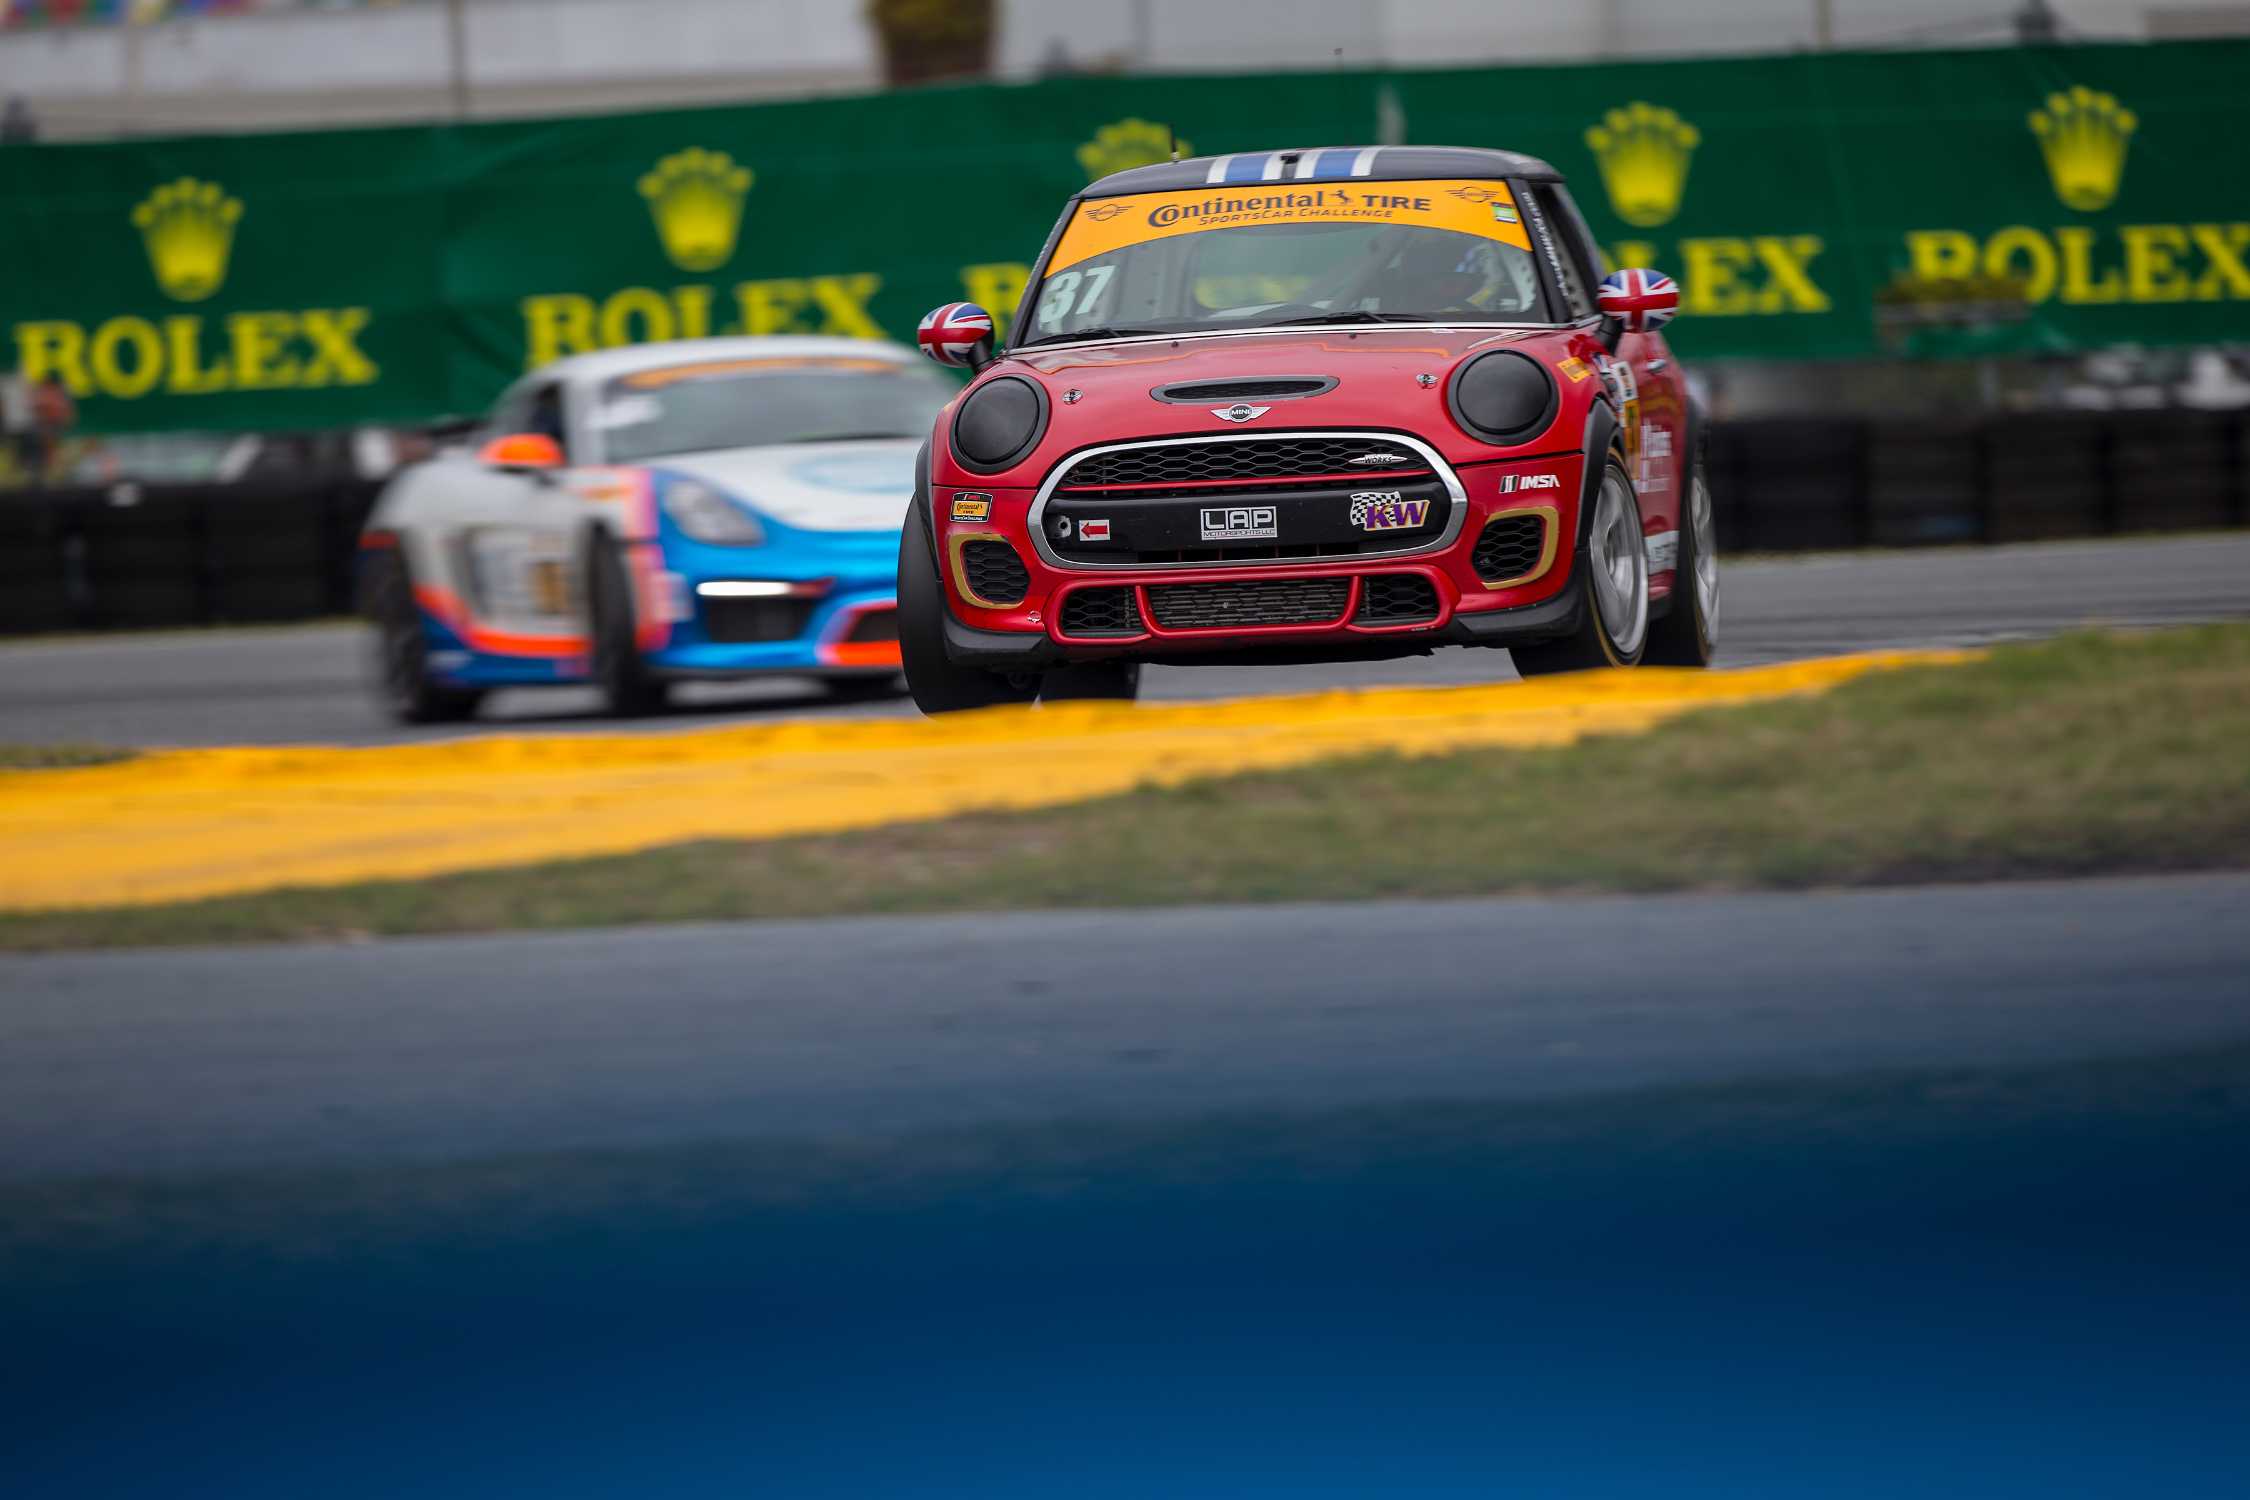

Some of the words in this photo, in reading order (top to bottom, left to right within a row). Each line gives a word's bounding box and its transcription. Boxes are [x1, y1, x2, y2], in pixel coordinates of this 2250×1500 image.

[1147, 190, 1324, 228] Continental
[1361, 194, 1432, 212] TIRE
[1199, 210, 1293, 226] SPORTSCAR
[1299, 208, 1393, 218] CHALLENGE
[1906, 223, 2250, 305] ROLEX
[1039, 265, 1117, 324] 37
[523, 273, 889, 378] ROLEX
[13, 307, 379, 398] ROLEX
[1364, 456, 1392, 464] WORKS
[1520, 475, 1561, 490] IMSA
[1205, 510, 1272, 529] LAP
[1364, 500, 1430, 530] KW
